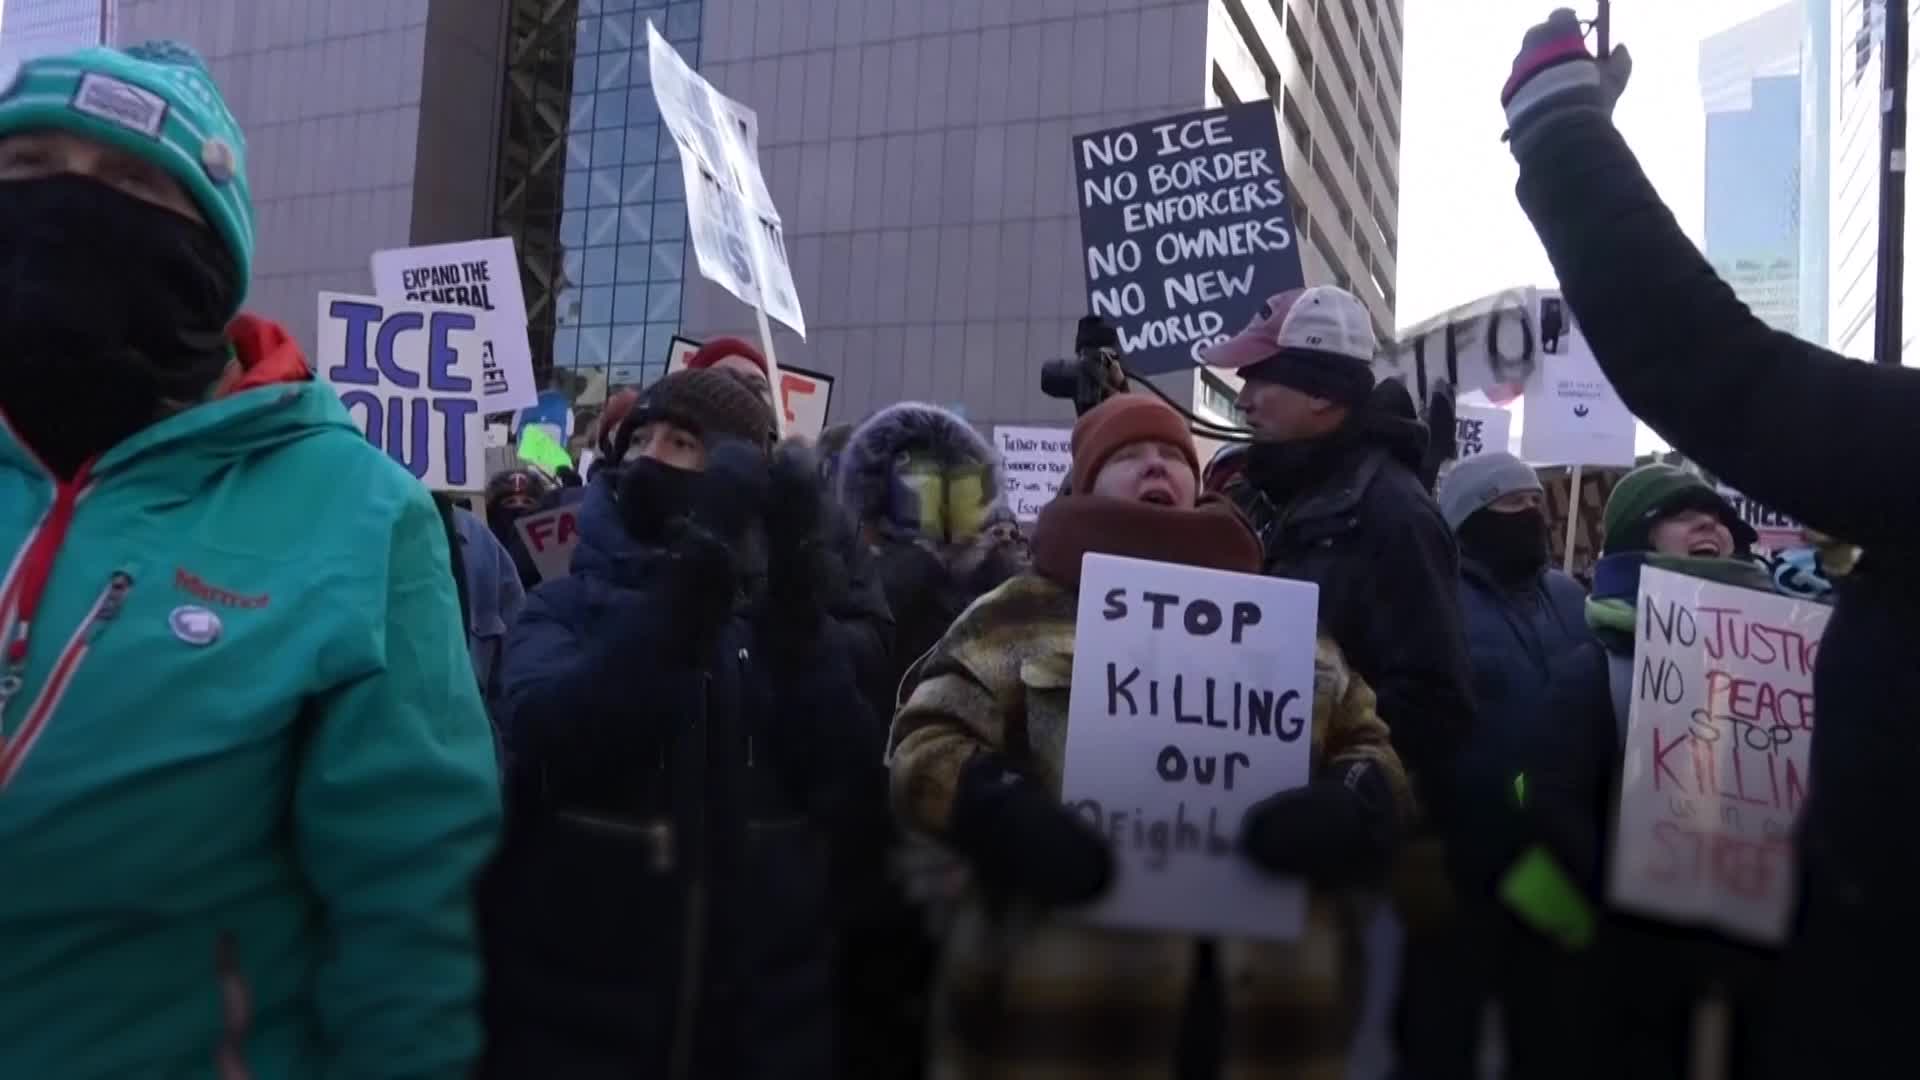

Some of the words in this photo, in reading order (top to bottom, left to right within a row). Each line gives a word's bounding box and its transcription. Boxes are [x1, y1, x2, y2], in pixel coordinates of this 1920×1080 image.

[1082, 132, 1138, 169] NO
[1152, 115, 1233, 156] ICE
[1084, 171, 1138, 208] NO
[1148, 149, 1274, 195] BORDER
[1123, 178, 1285, 233] ENFORCERS
[403, 264, 462, 291] EXPAND
[462, 260, 491, 285] THE
[1087, 239, 1142, 280] NO
[1156, 217, 1291, 265] OWNERS
[1091, 282, 1146, 318] NO
[1164, 264, 1255, 309] NEW
[329, 301, 476, 393] ICE
[1116, 310, 1224, 354] WORLD
[1102, 588, 1262, 644] STOP
[1645, 595, 1696, 647] NO
[1106, 662, 1305, 743] KILLING
[1641, 655, 1684, 704] NO
[1689, 708, 1793, 756] STOP
